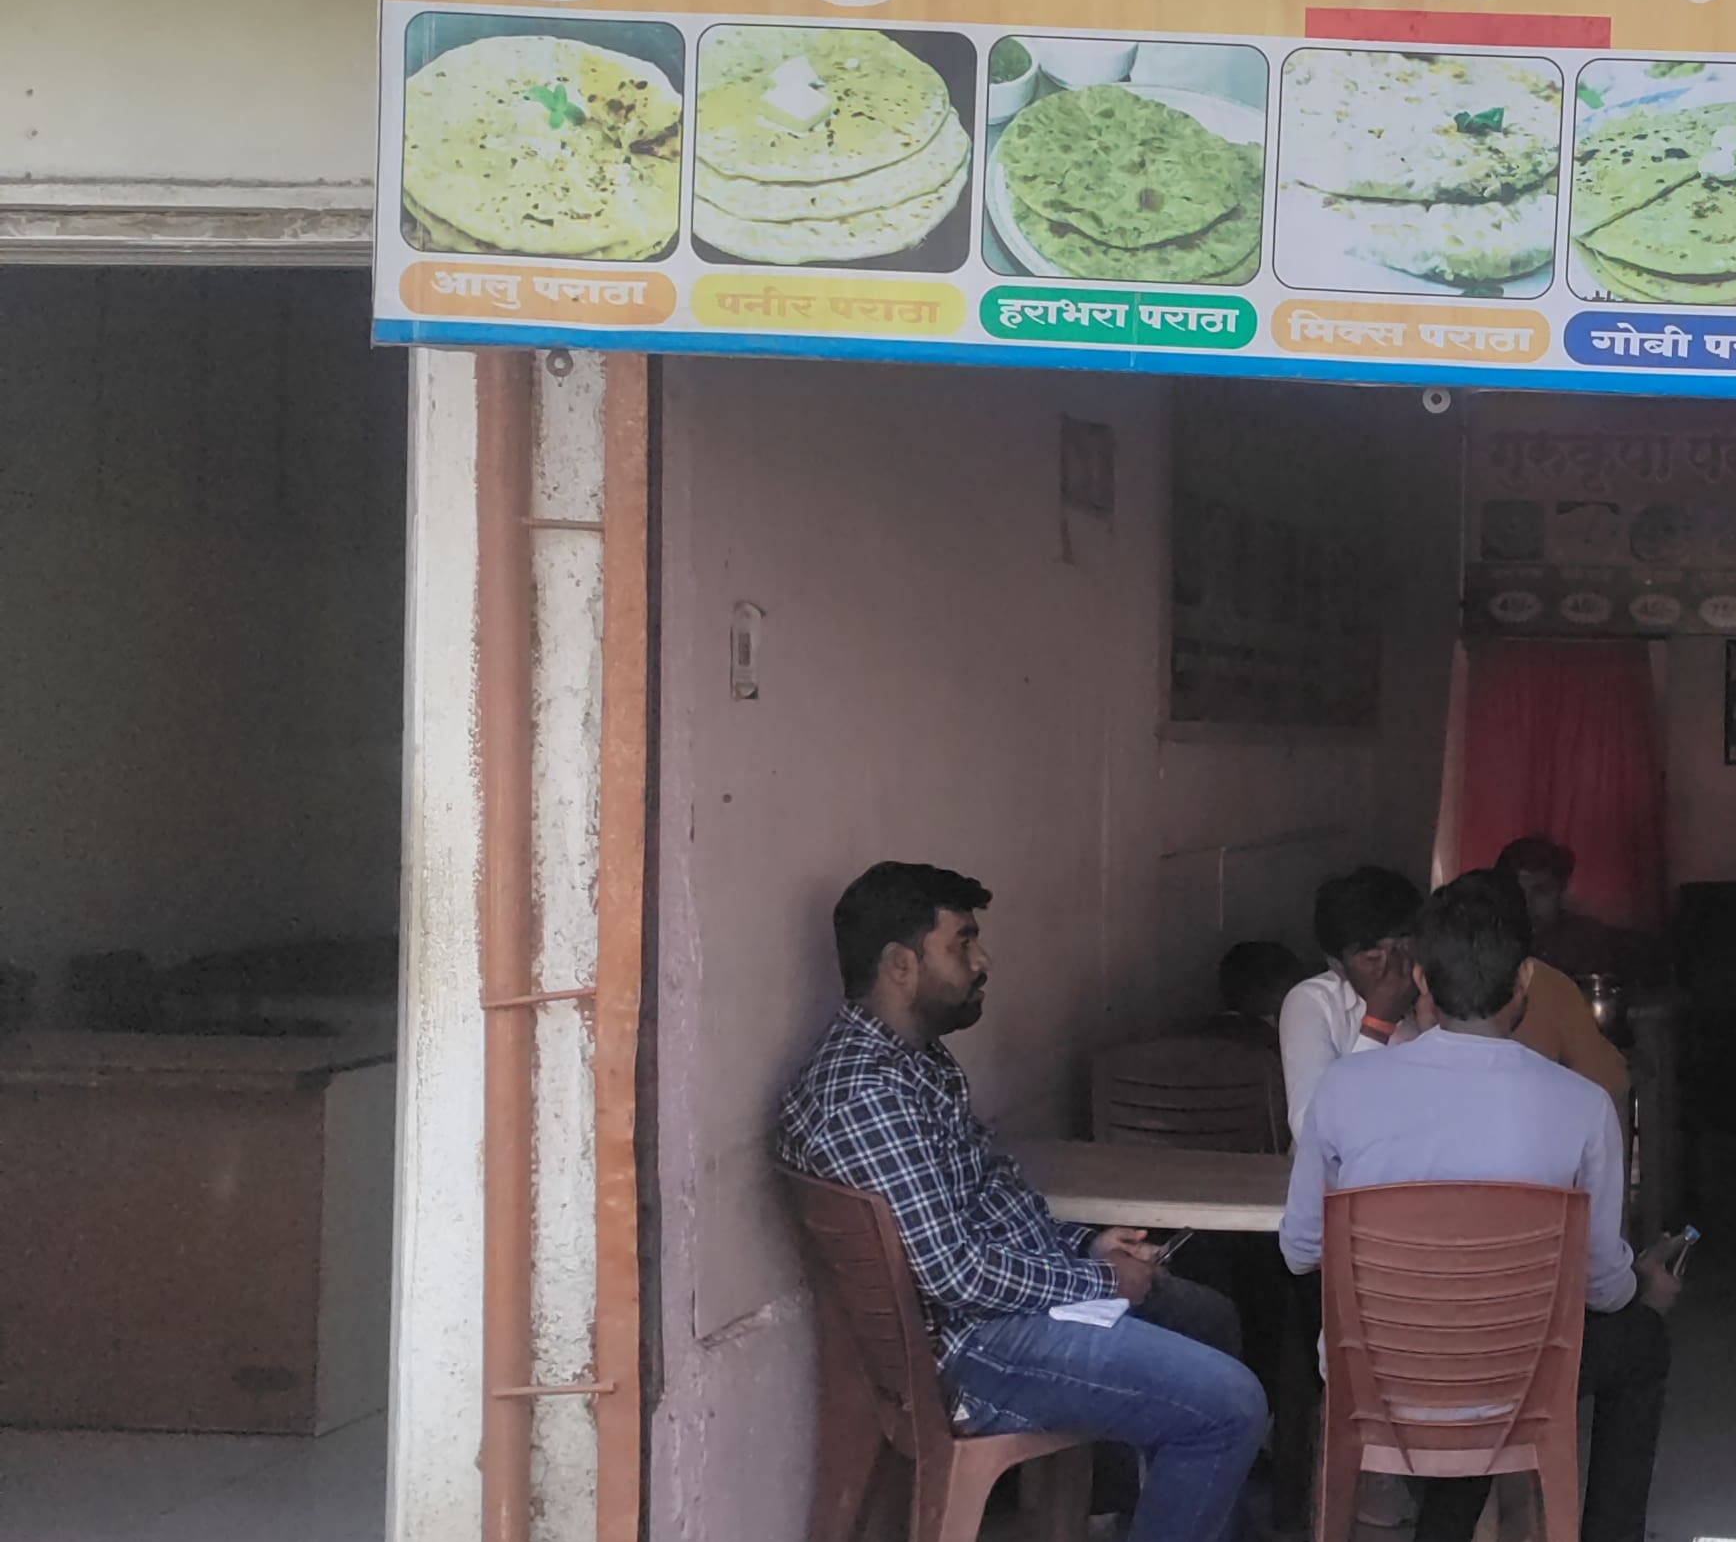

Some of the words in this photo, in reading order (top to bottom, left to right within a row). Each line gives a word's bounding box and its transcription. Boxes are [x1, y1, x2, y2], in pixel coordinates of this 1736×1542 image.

[430, 269, 522, 310] आलु
[532, 274, 649, 306] पराठा
[715, 283, 817, 318] पनीर
[825, 295, 941, 325] पराठा
[998, 297, 1129, 330] हराभरा
[1139, 304, 1240, 335] पराठा
[1287, 309, 1406, 347] मिक्स
[1417, 321, 1535, 352] पराठा
[1590, 320, 1692, 360] गोबी
